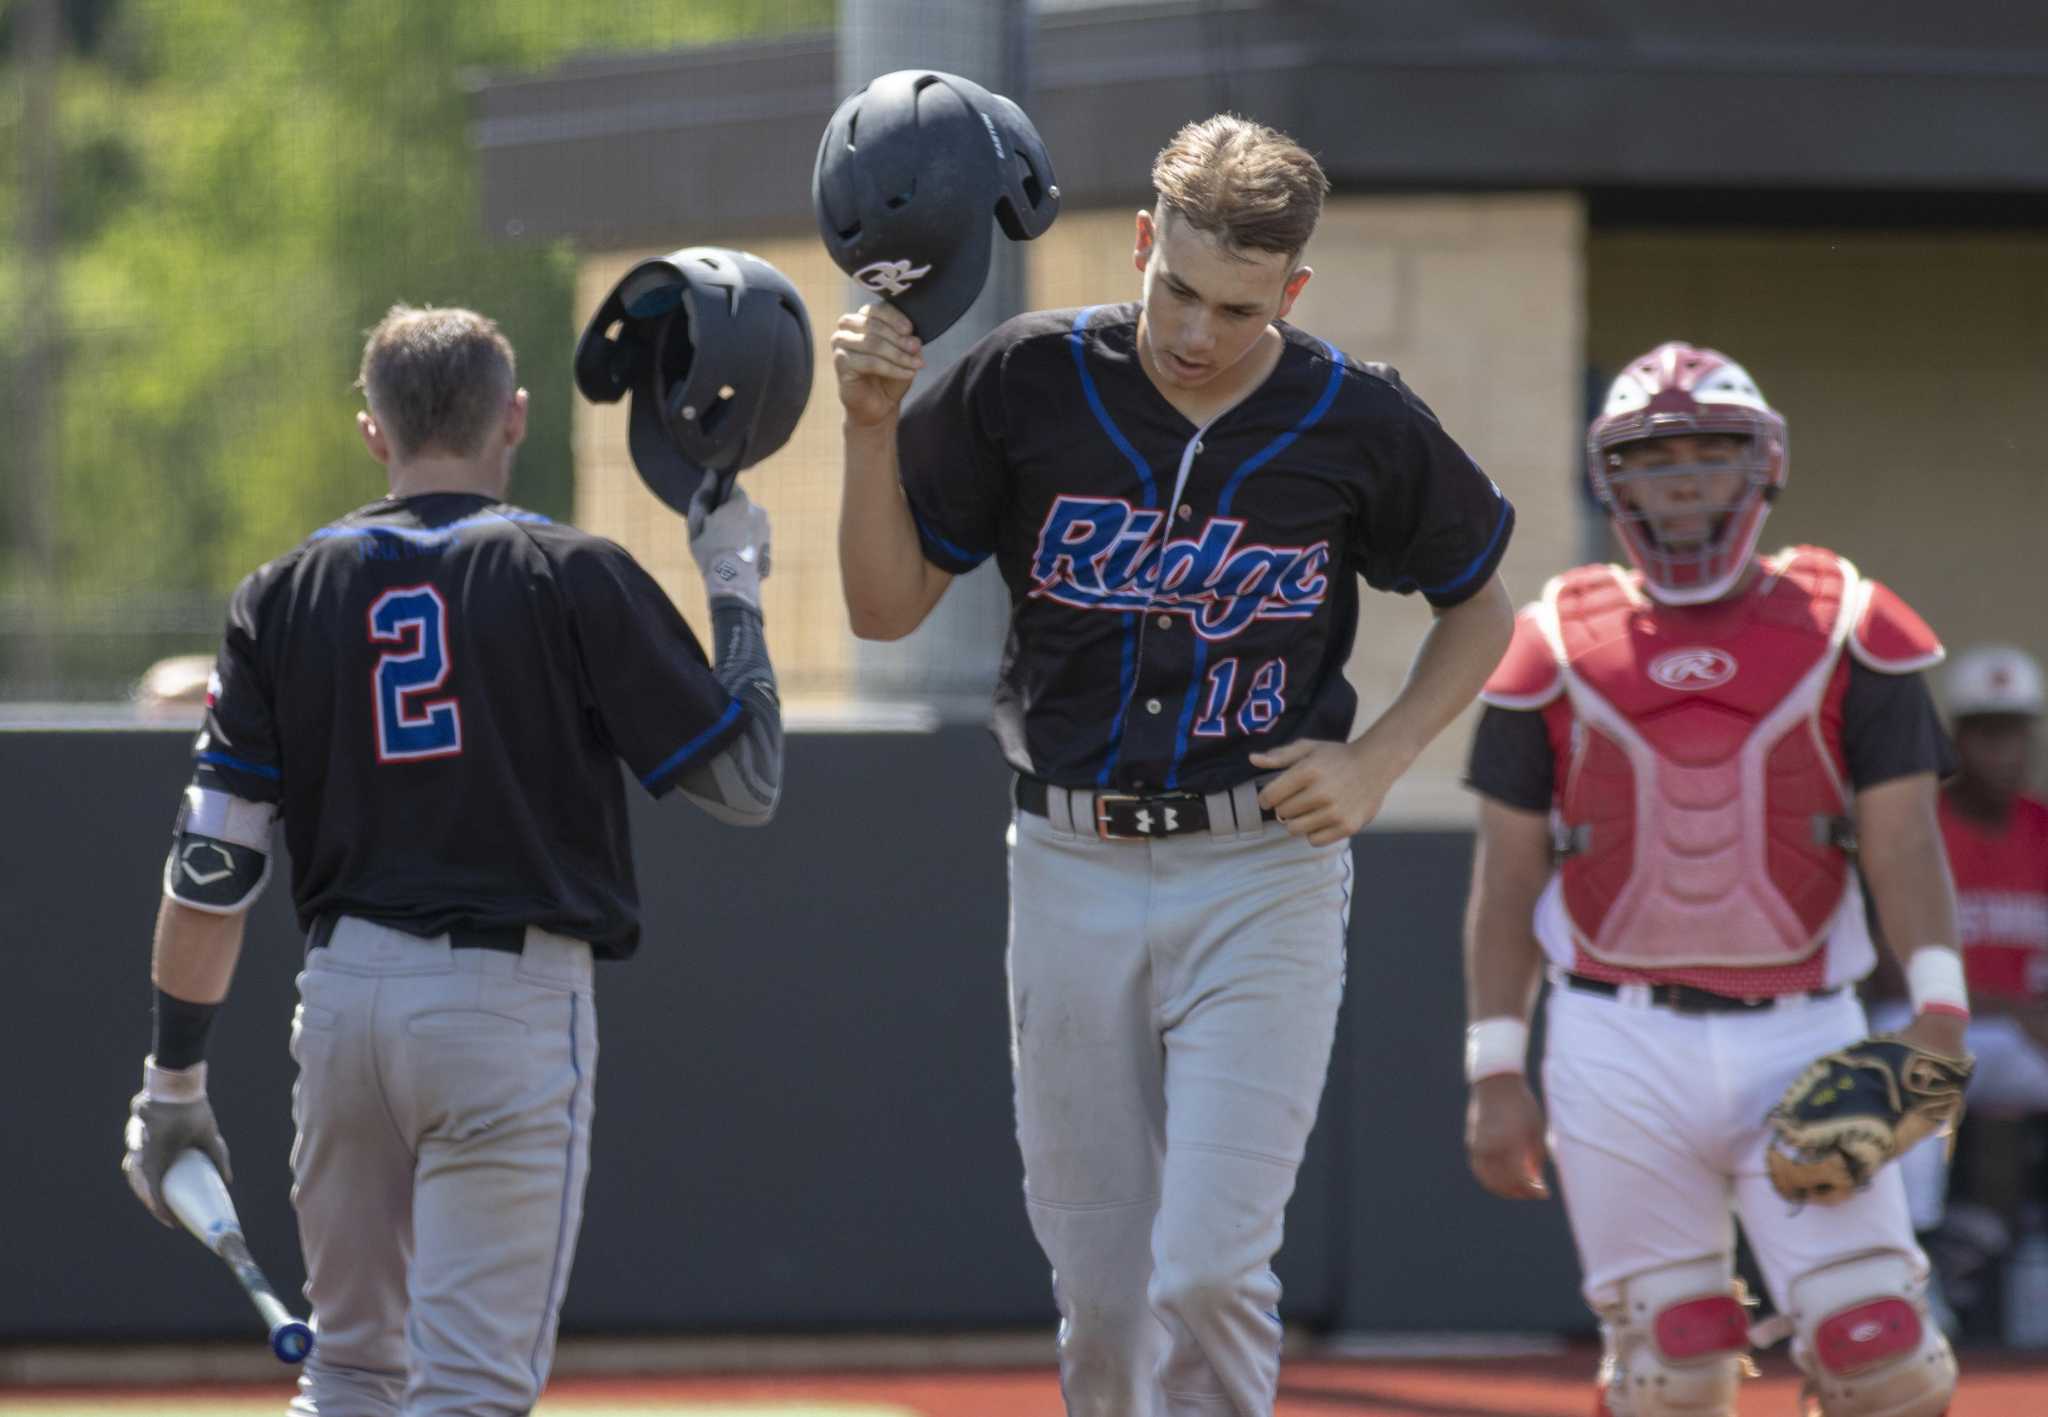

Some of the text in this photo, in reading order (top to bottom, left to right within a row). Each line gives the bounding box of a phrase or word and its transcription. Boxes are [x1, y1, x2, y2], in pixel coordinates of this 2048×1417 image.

[1028, 495, 1330, 640] Ridge
[368, 582, 463, 764] 2
[1192, 656, 1287, 738] 18
